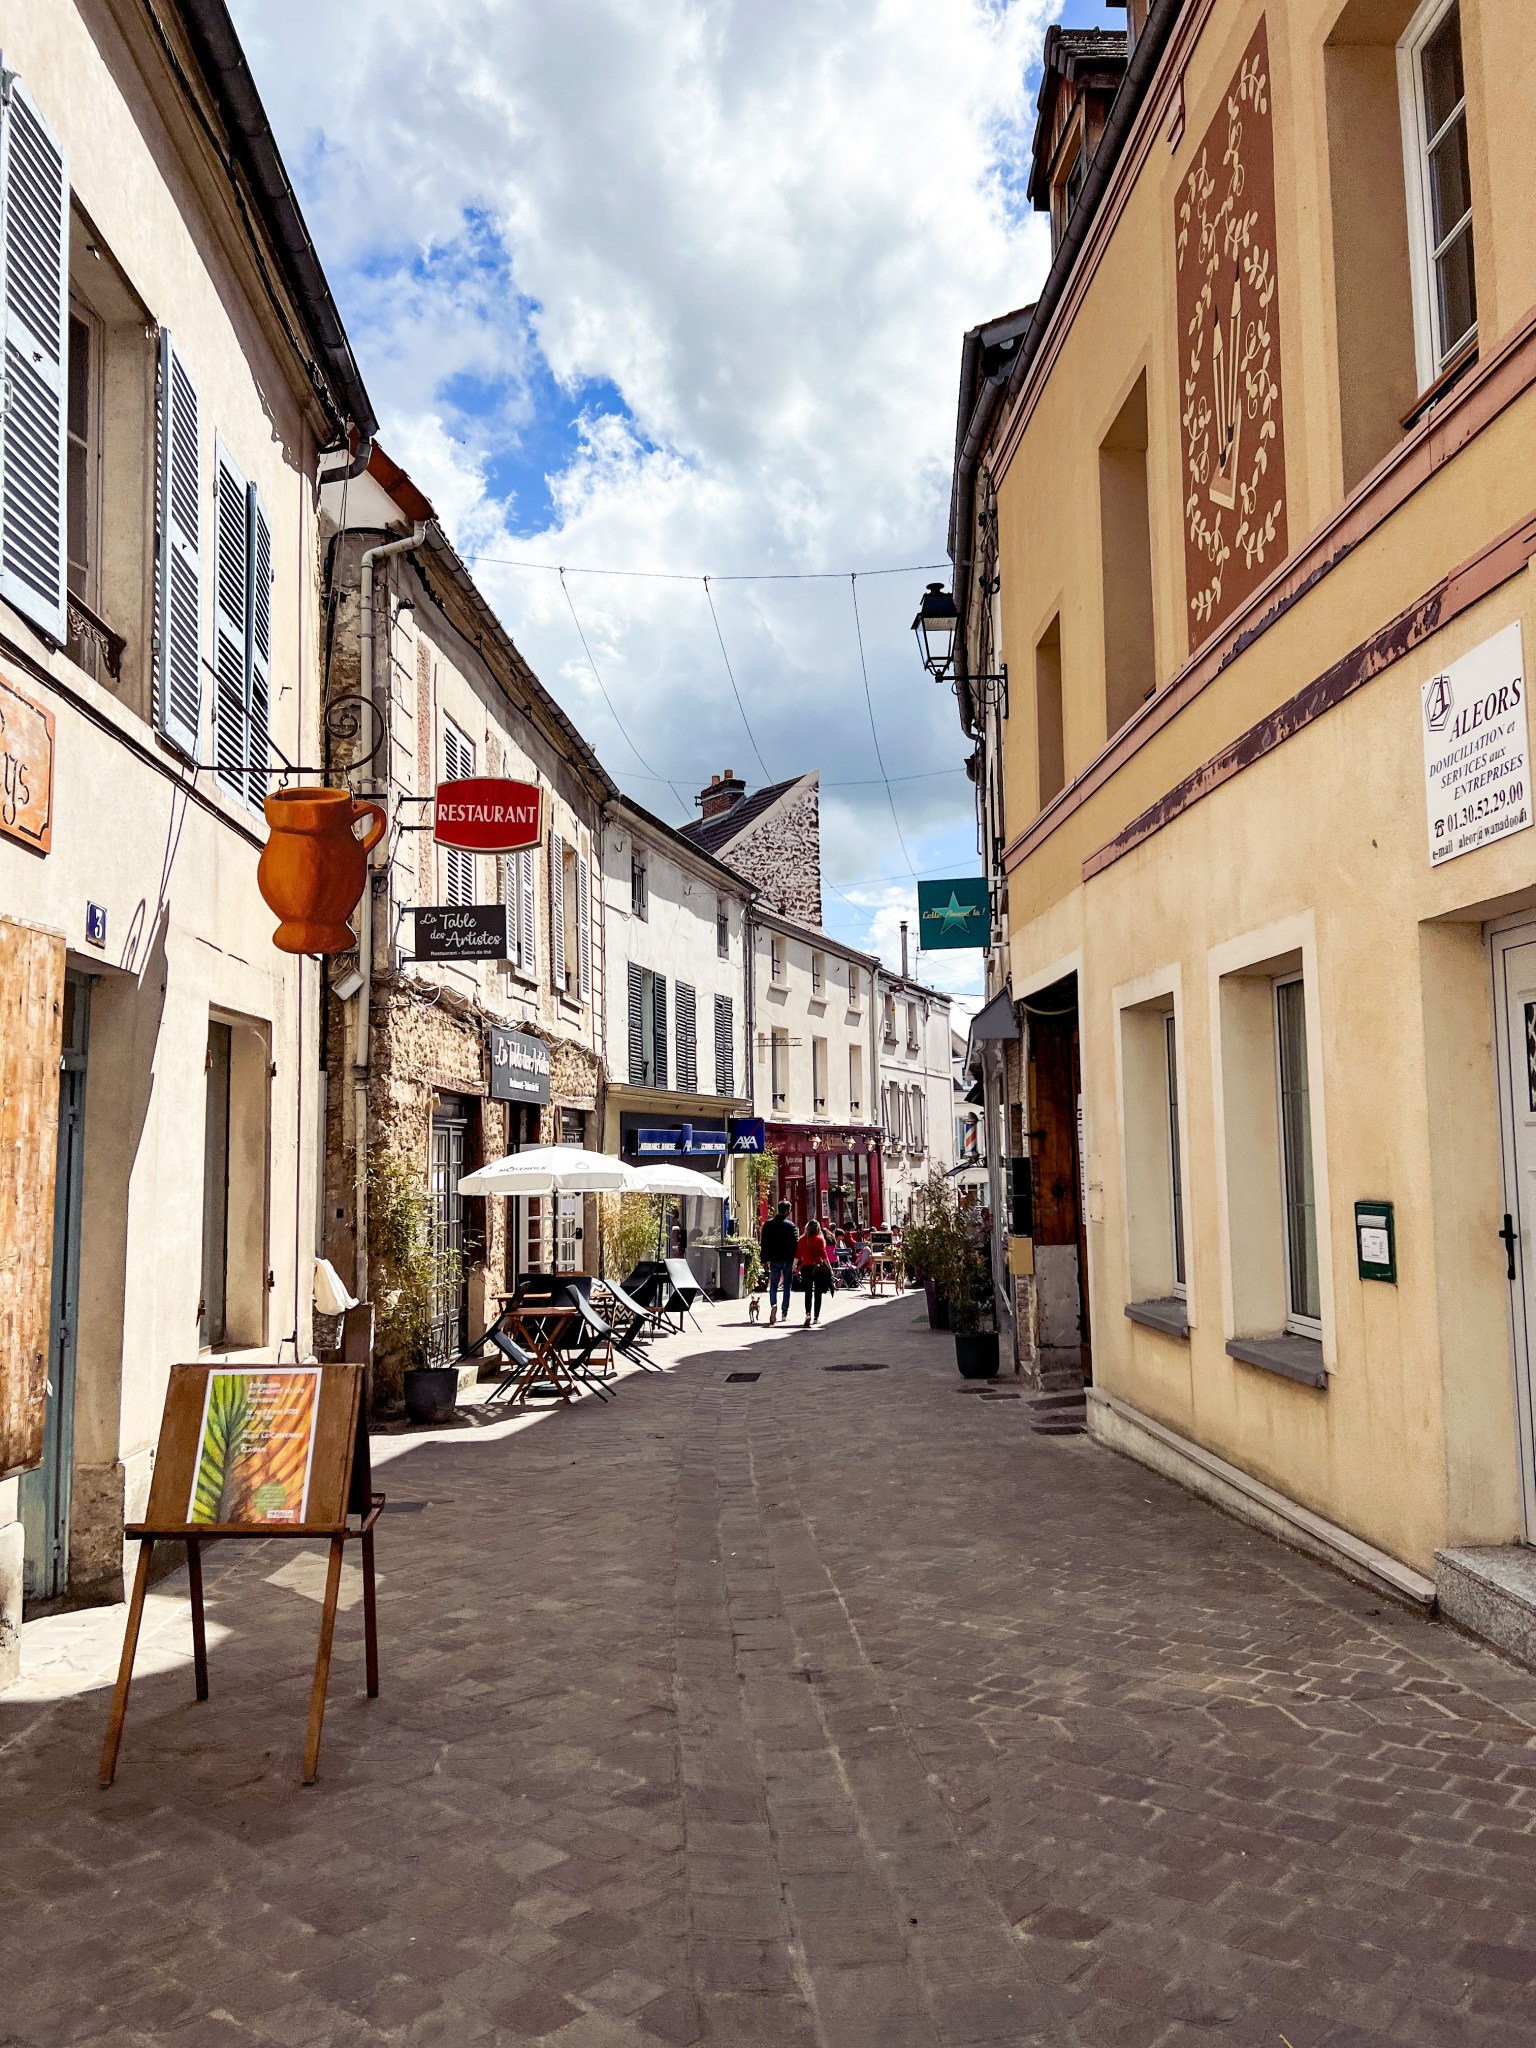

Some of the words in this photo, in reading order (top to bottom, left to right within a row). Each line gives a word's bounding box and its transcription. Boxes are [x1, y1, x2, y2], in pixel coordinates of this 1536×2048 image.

[1449, 677, 1522, 743] ALEORS
[1429, 723, 1506, 778] DOMICILIATION
[1507, 721, 1516, 734] et
[1440, 753, 1488, 789] SERVICES
[1489, 746, 1506, 763] aux
[1453, 753, 1524, 801] ENTREPRISES
[437, 803, 537, 824] RESTAURANT
[1447, 781, 1524, 833] 01.30.52.29.00
[95, 909, 104, 939] 3
[420, 912, 438, 925] La
[439, 912, 477, 930] Table
[430, 929, 446, 940] des
[444, 930, 503, 948] Artistes
[732, 1135, 759, 1150] AXA
